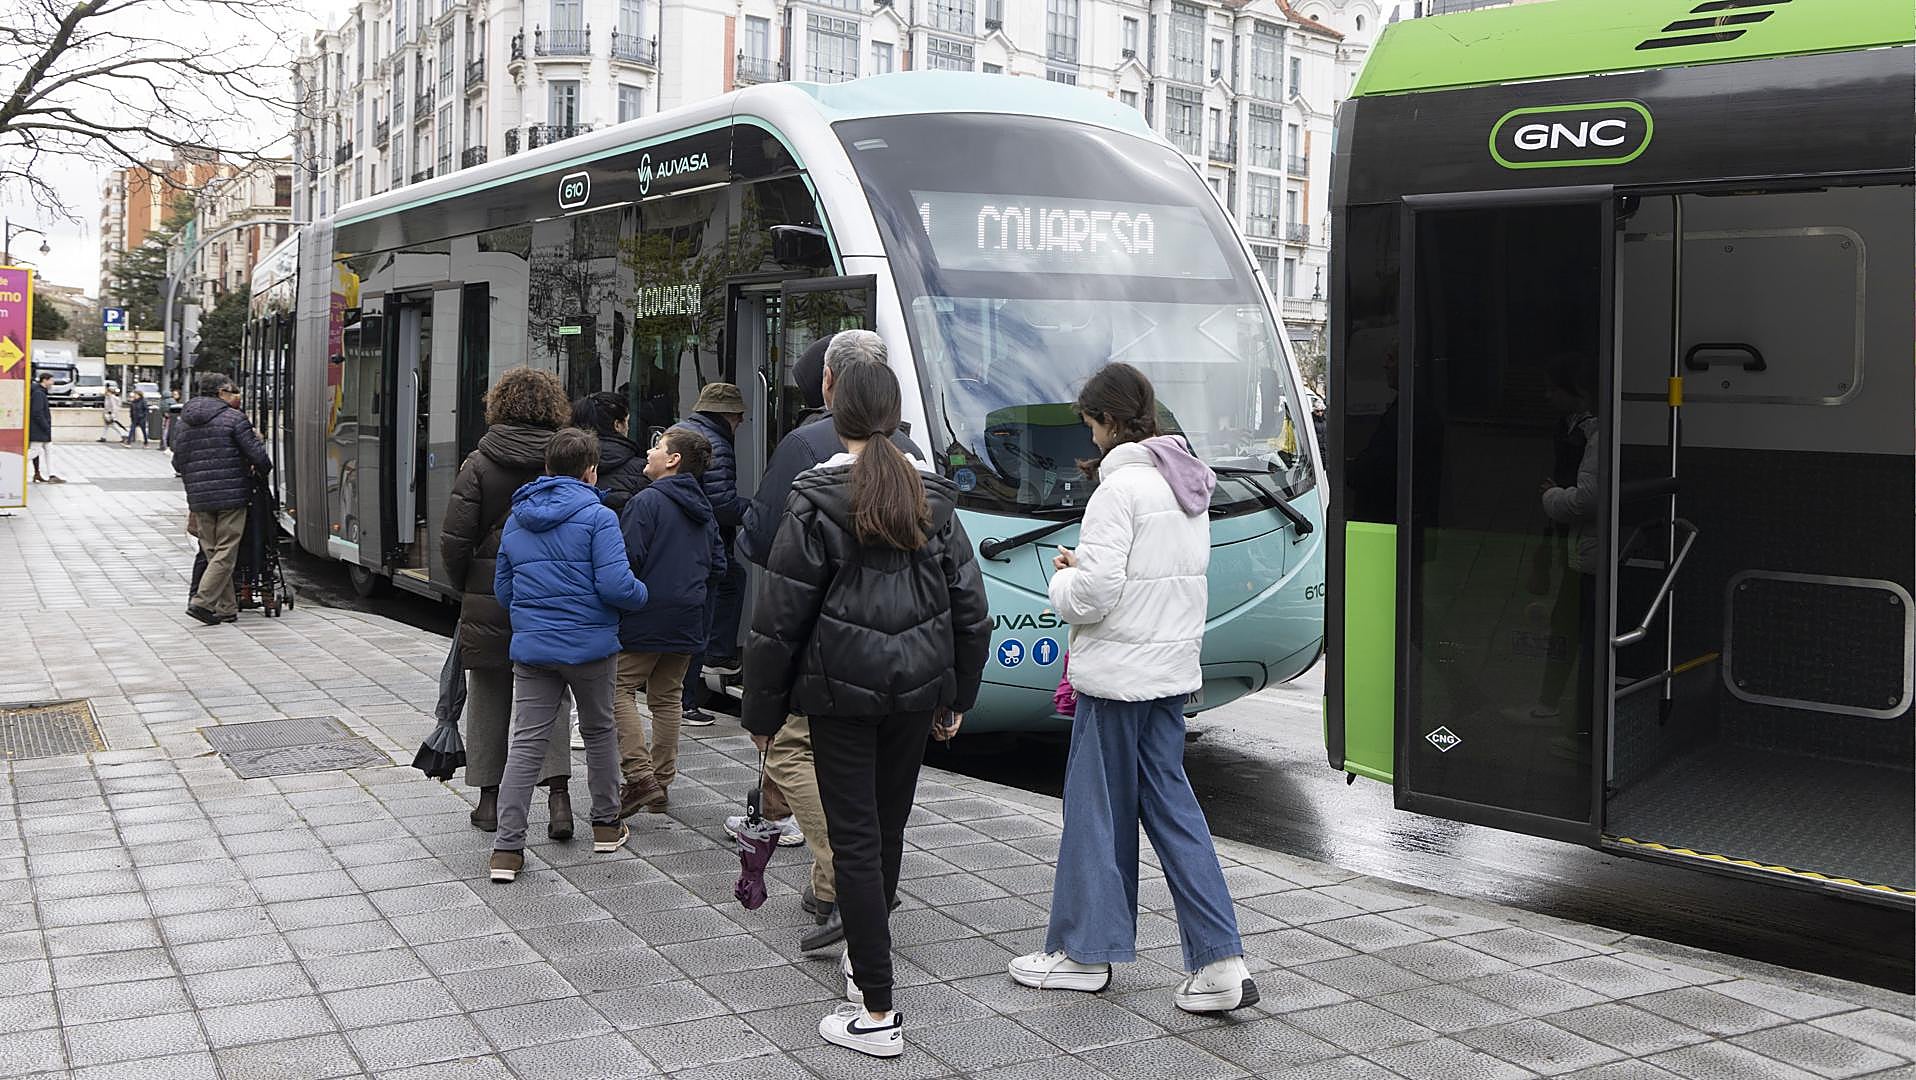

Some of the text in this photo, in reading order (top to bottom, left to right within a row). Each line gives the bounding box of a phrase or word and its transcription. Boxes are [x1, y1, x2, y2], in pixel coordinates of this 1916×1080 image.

[1514, 119, 1626, 150] GNC
[656, 152, 709, 179] AUVASA
[565, 181, 583, 199] 610
[107, 310, 119, 323] P
[1431, 734, 1455, 744] CNG
